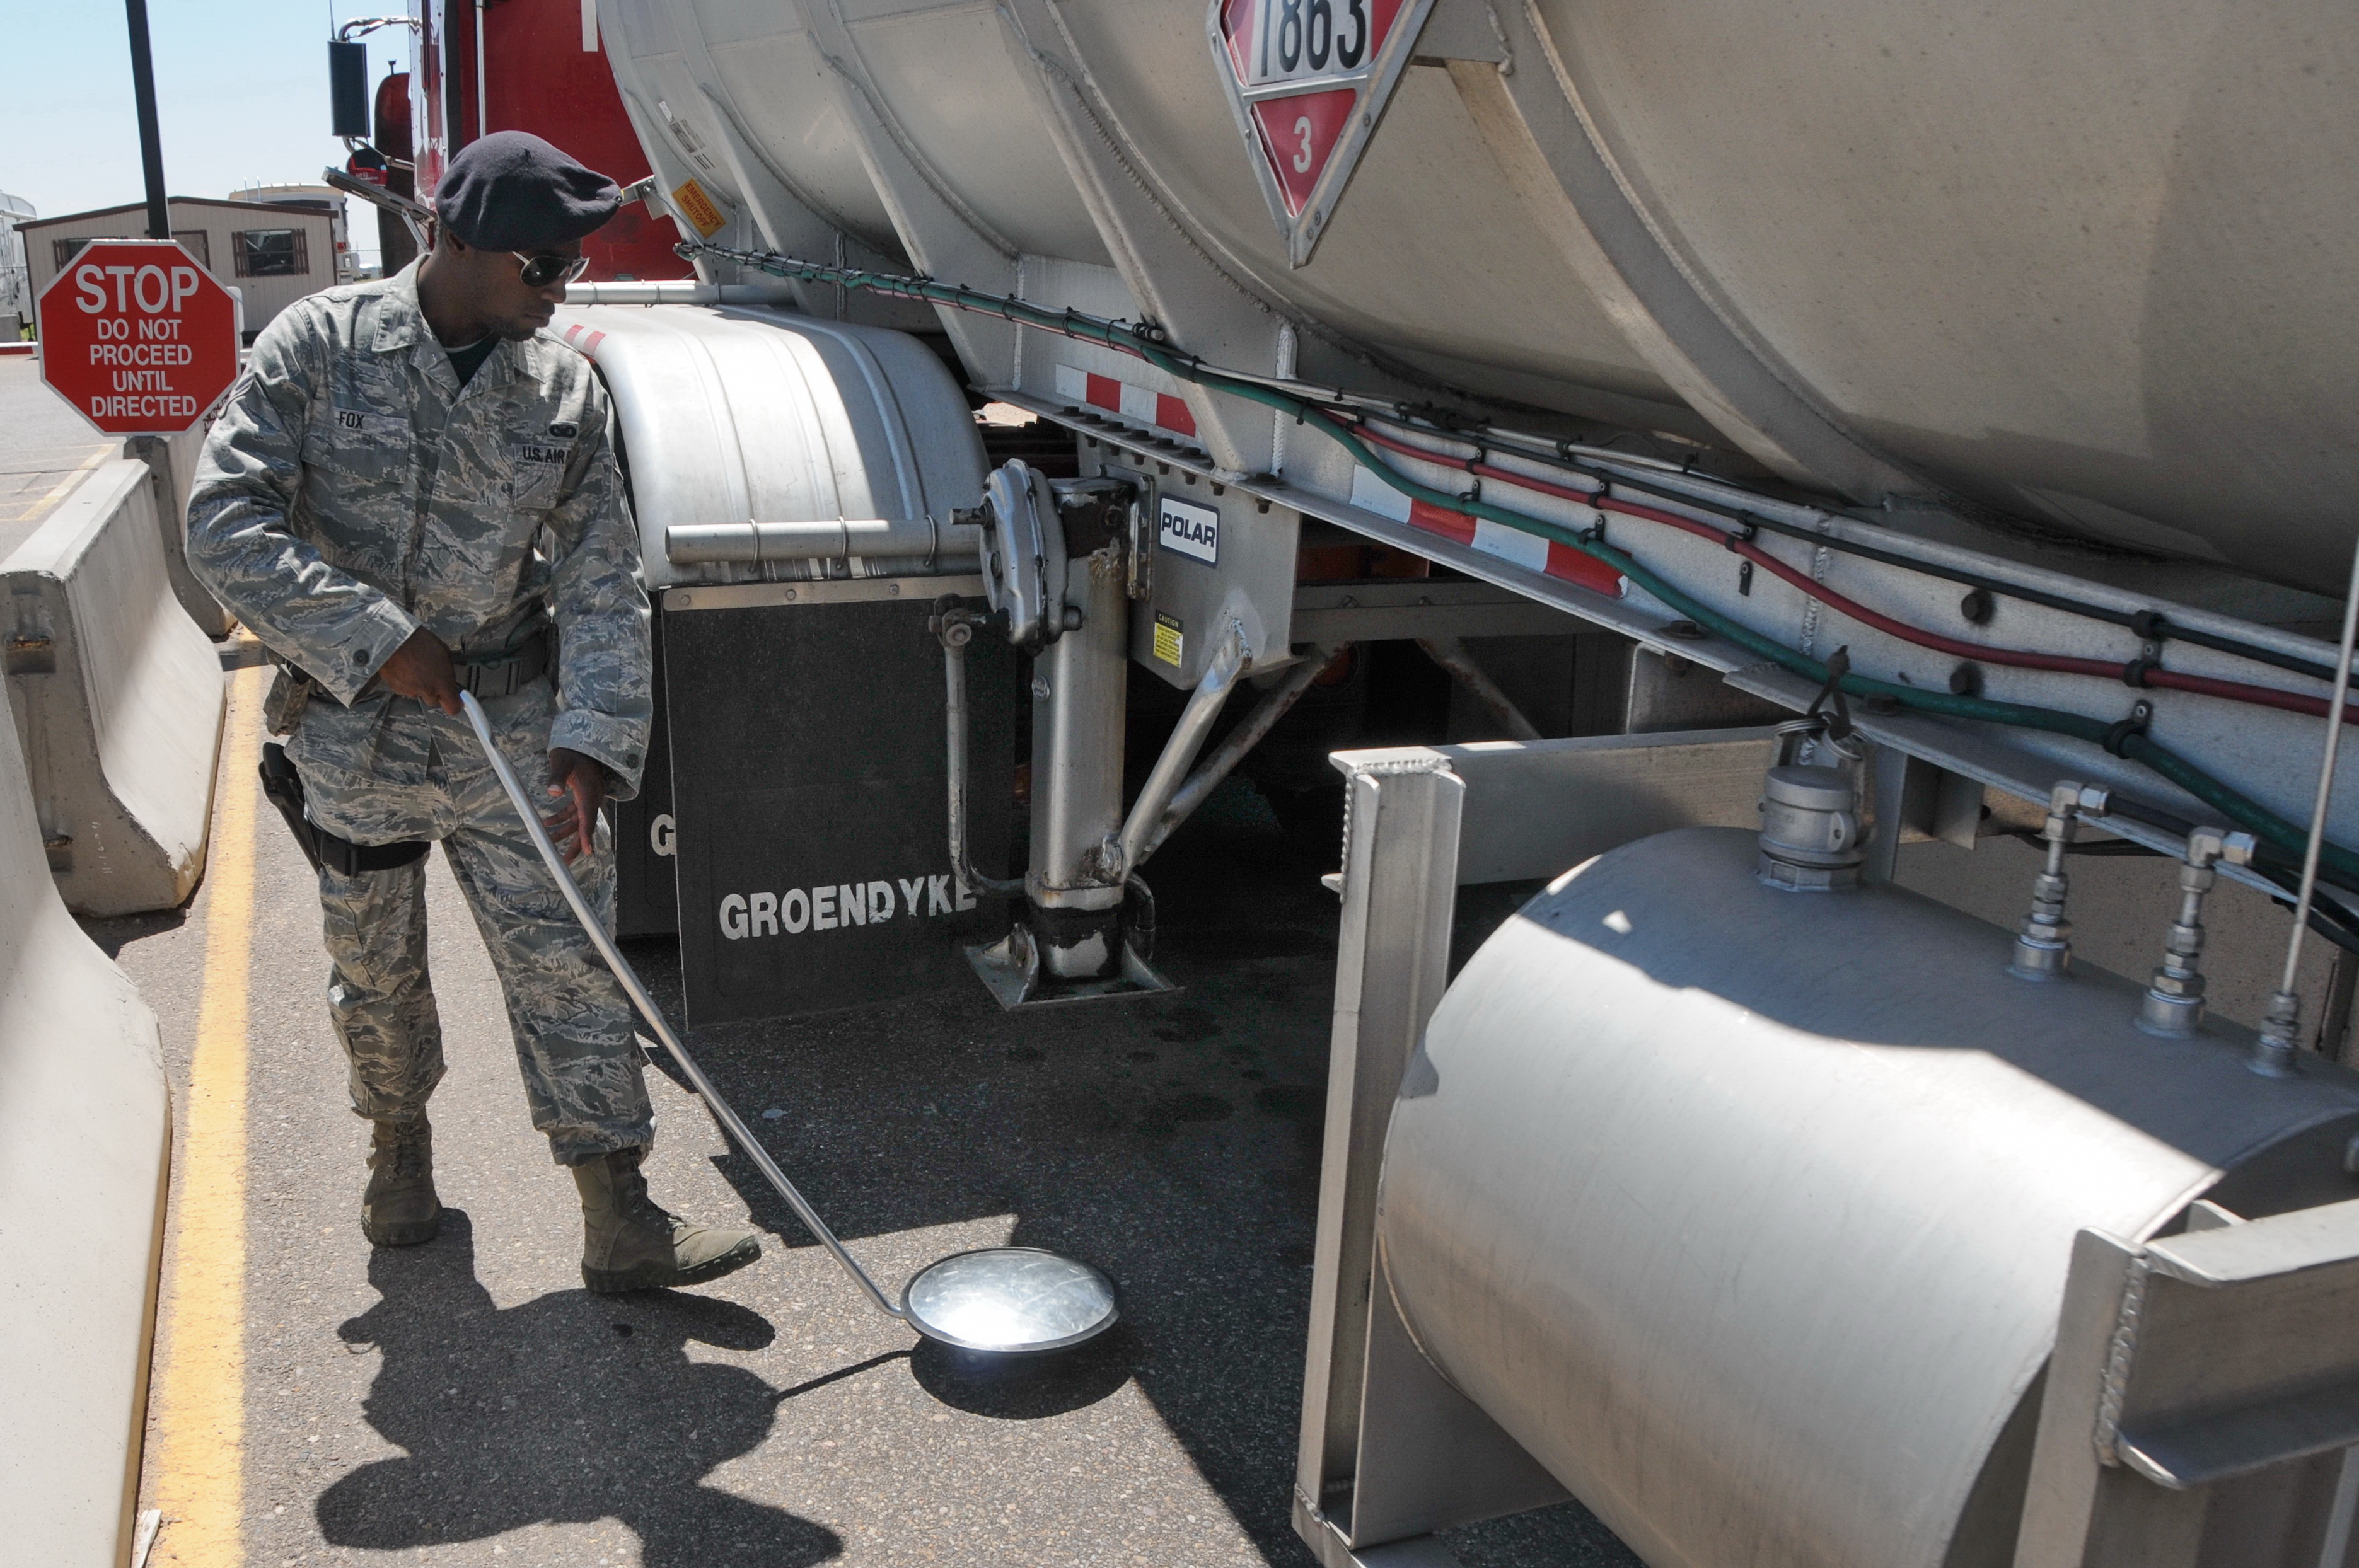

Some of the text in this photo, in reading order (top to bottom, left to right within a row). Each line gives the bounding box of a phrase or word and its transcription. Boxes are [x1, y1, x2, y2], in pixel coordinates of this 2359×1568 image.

[1261, 0, 1366, 77] 1863
[1293, 116, 1312, 173] 3
[681, 195, 709, 227] SHUTOFF
[685, 183, 721, 227] EMERGENCY
[75, 264, 199, 314] STOP
[97, 318, 182, 340] DO NOT
[90, 343, 192, 366] PROCEED
[112, 370, 173, 392] UNTIL
[91, 395, 197, 417] DIRECTED
[339, 411, 365, 429] FOX
[523, 446, 543, 462] U.S.
[545, 448, 565, 465] AIR
[1161, 512, 1216, 548] POLAR
[1158, 613, 1180, 628] CAUTION
[719, 875, 977, 940] GROENDYKE
